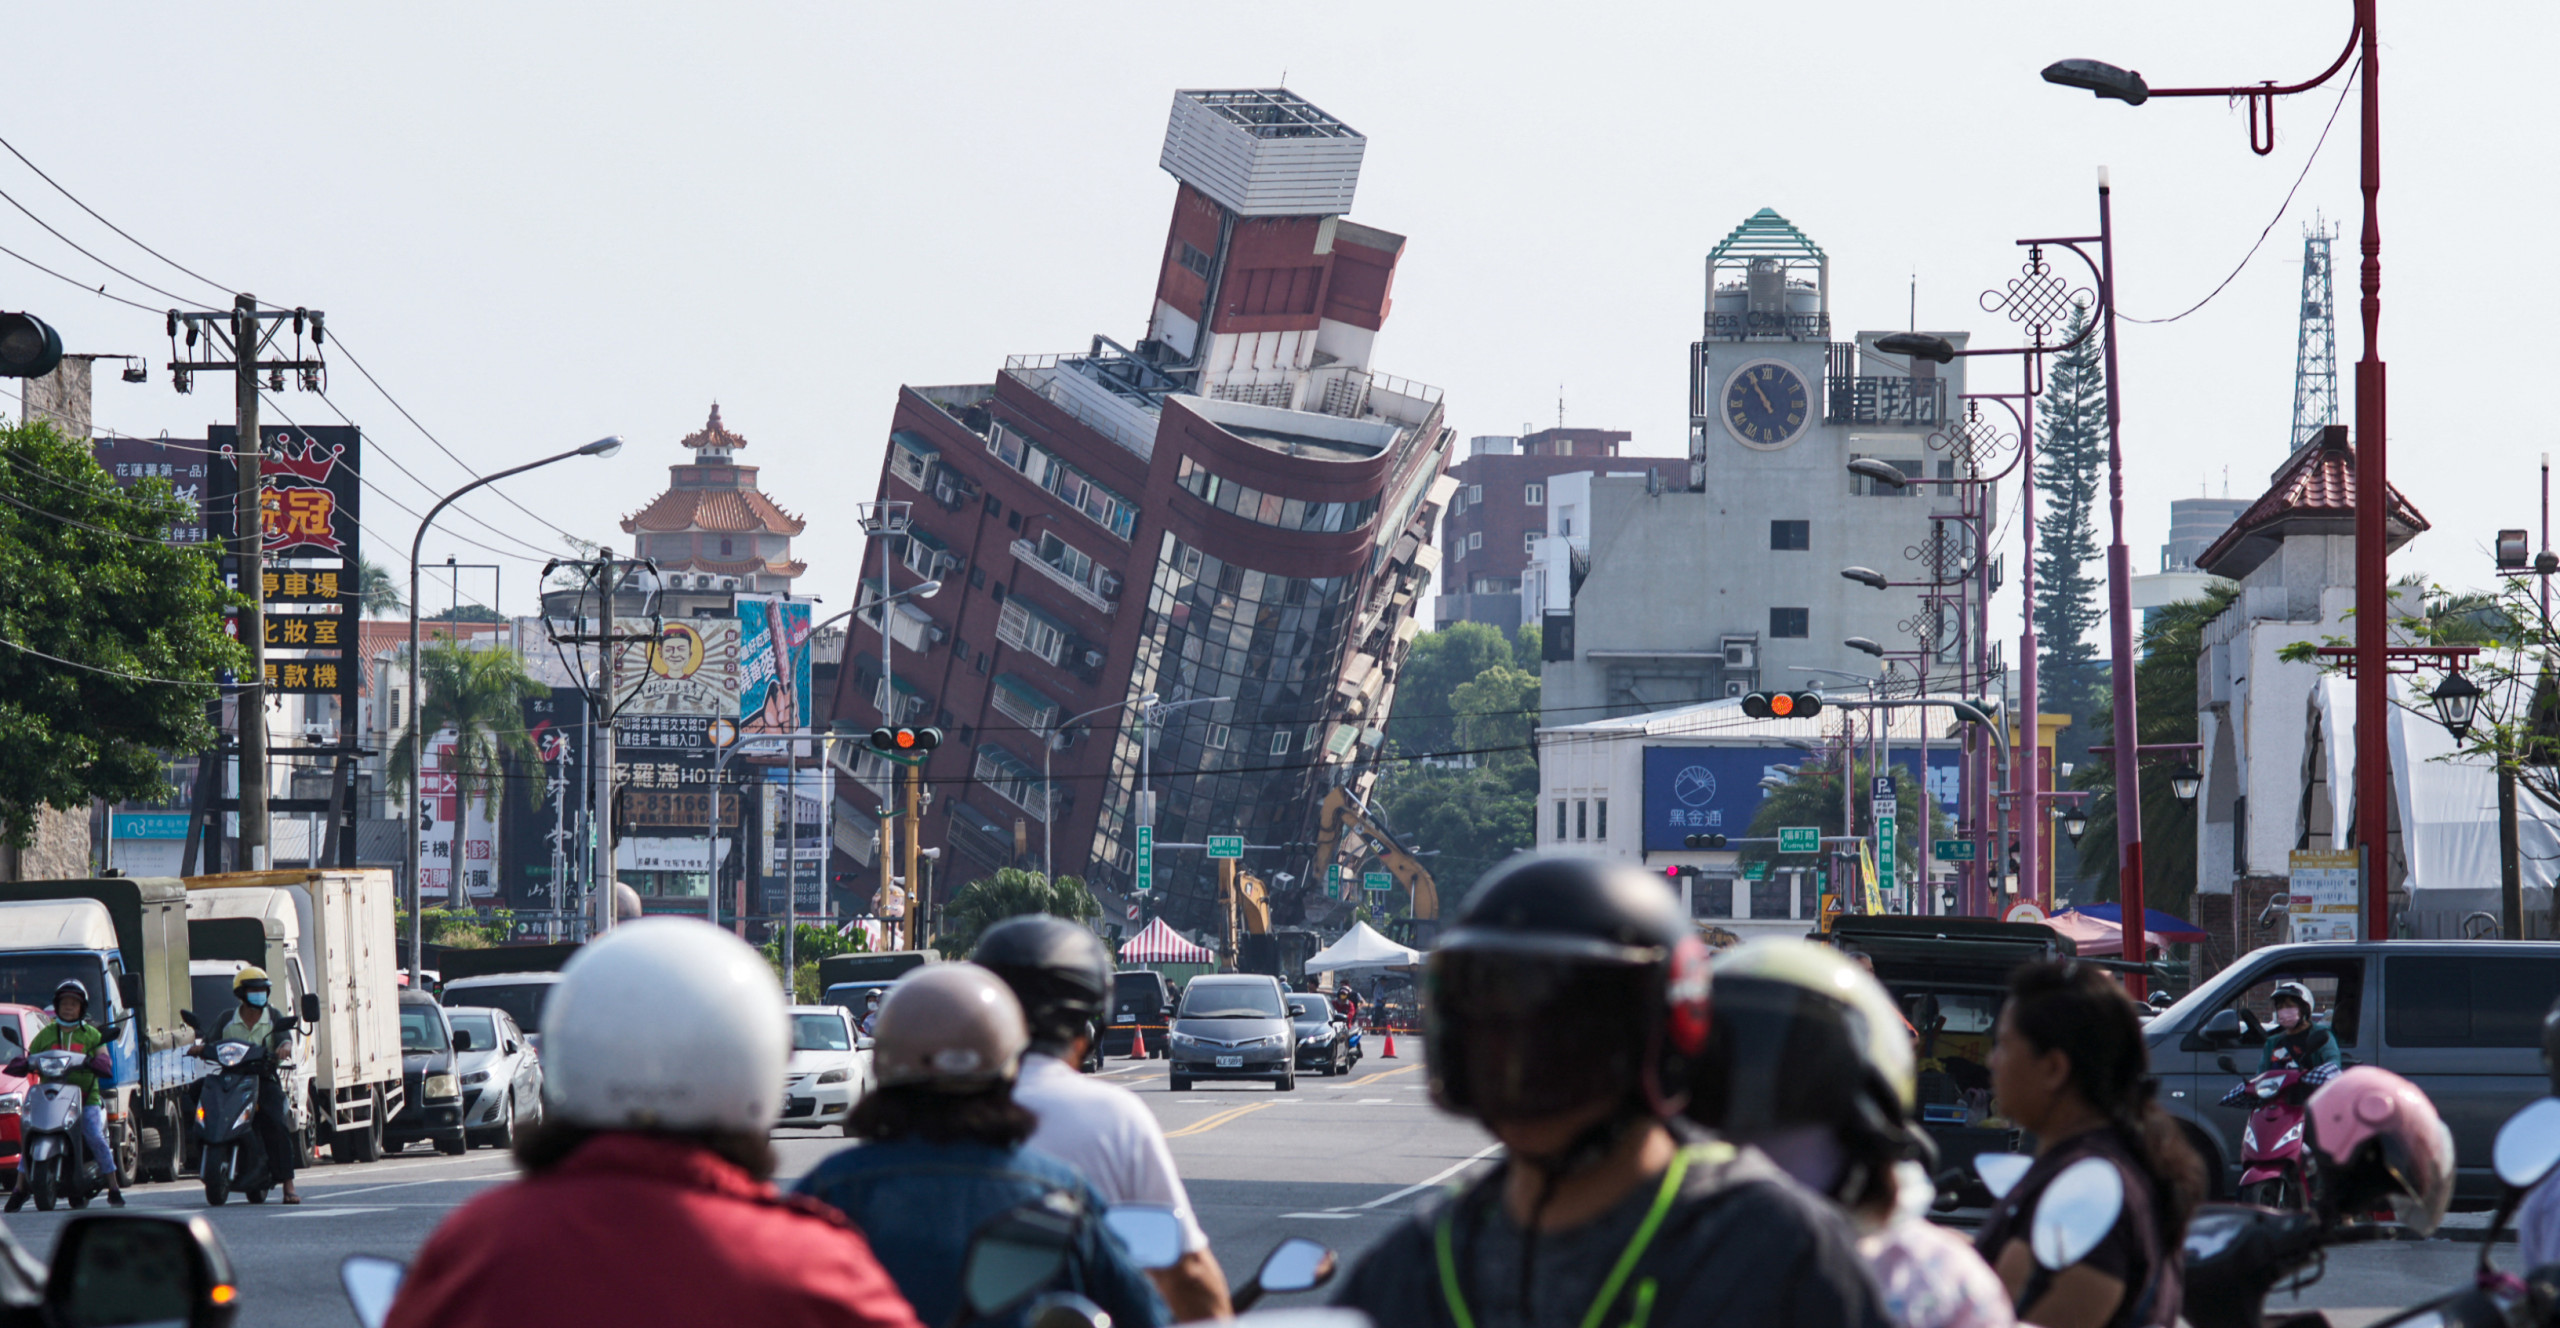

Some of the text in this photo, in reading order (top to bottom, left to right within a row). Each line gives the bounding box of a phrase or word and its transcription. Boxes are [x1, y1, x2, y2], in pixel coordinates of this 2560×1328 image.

[1704, 311, 1830, 332] Les Champs
[115, 462, 208, 478] 花蓮薯第一品
[681, 767, 737, 784] HOTEL
[1669, 808, 1722, 827] 黑金通
[1370, 838, 1384, 854] CAT
